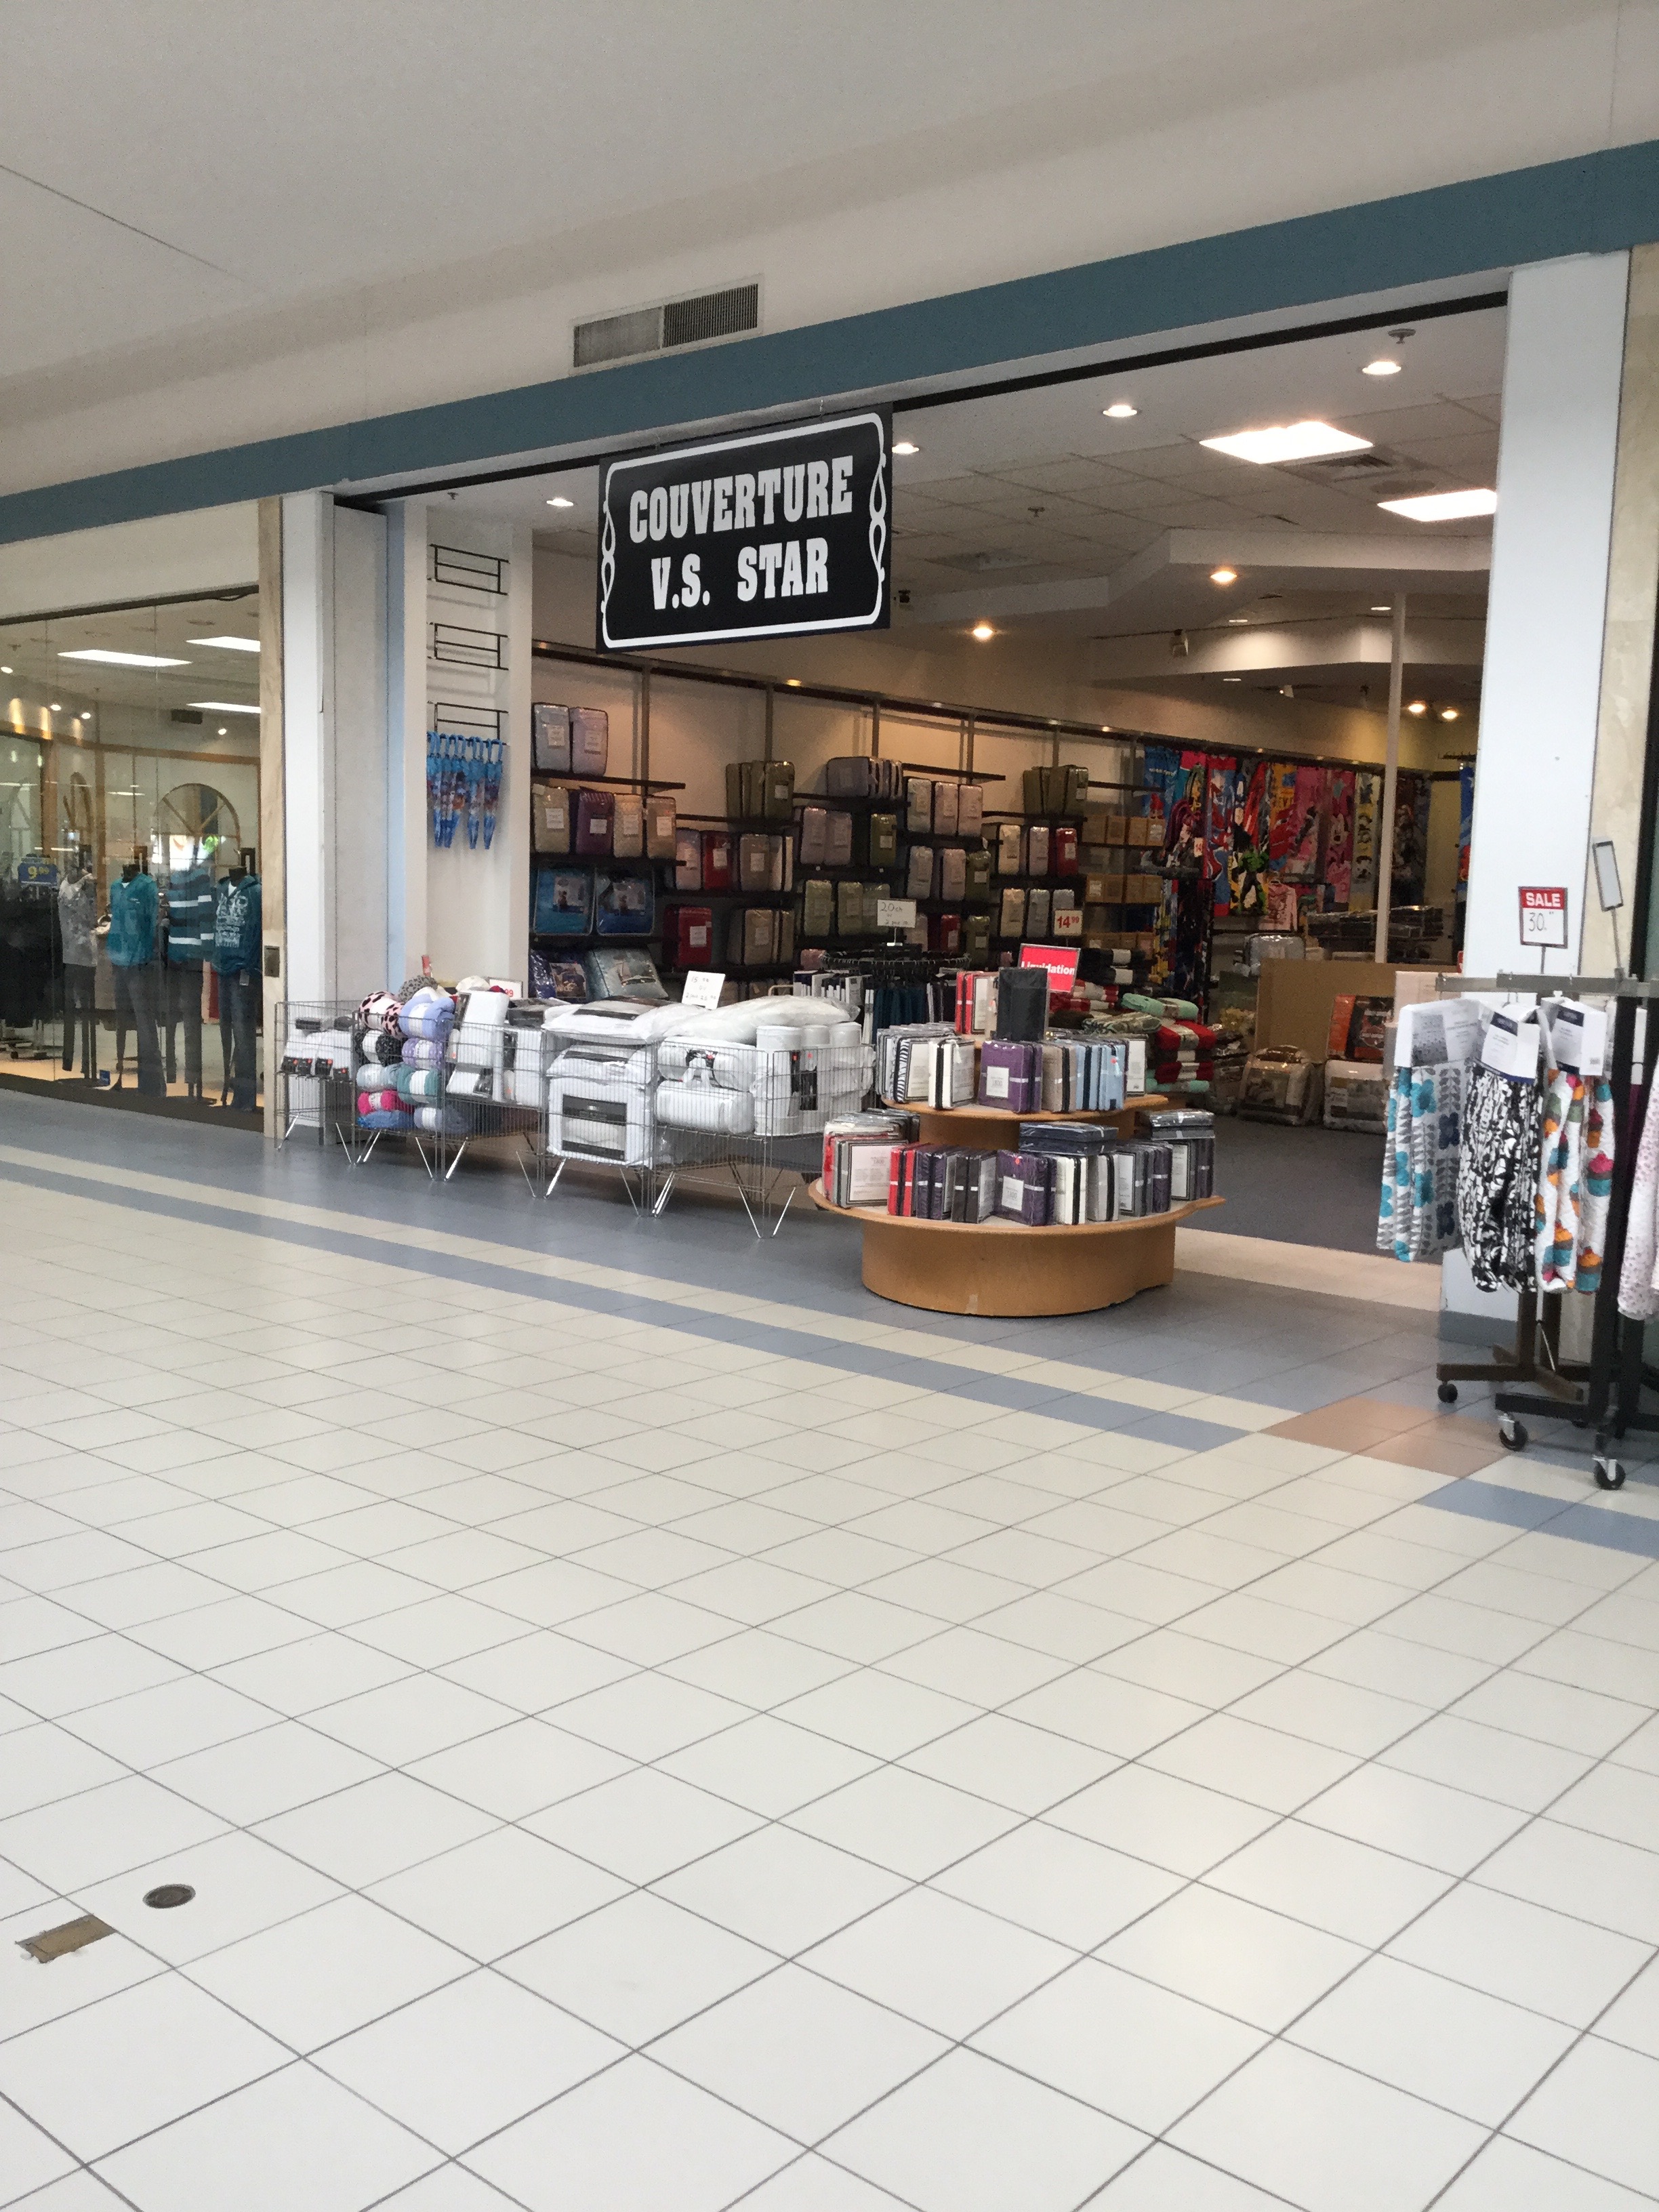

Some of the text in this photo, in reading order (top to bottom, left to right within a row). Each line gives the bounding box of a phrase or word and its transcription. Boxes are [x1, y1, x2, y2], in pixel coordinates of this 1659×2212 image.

[630, 455, 853, 543] COUVERTURE
[651, 537, 829, 610] V.S. STAR
[1525, 892, 1561, 907] SALE
